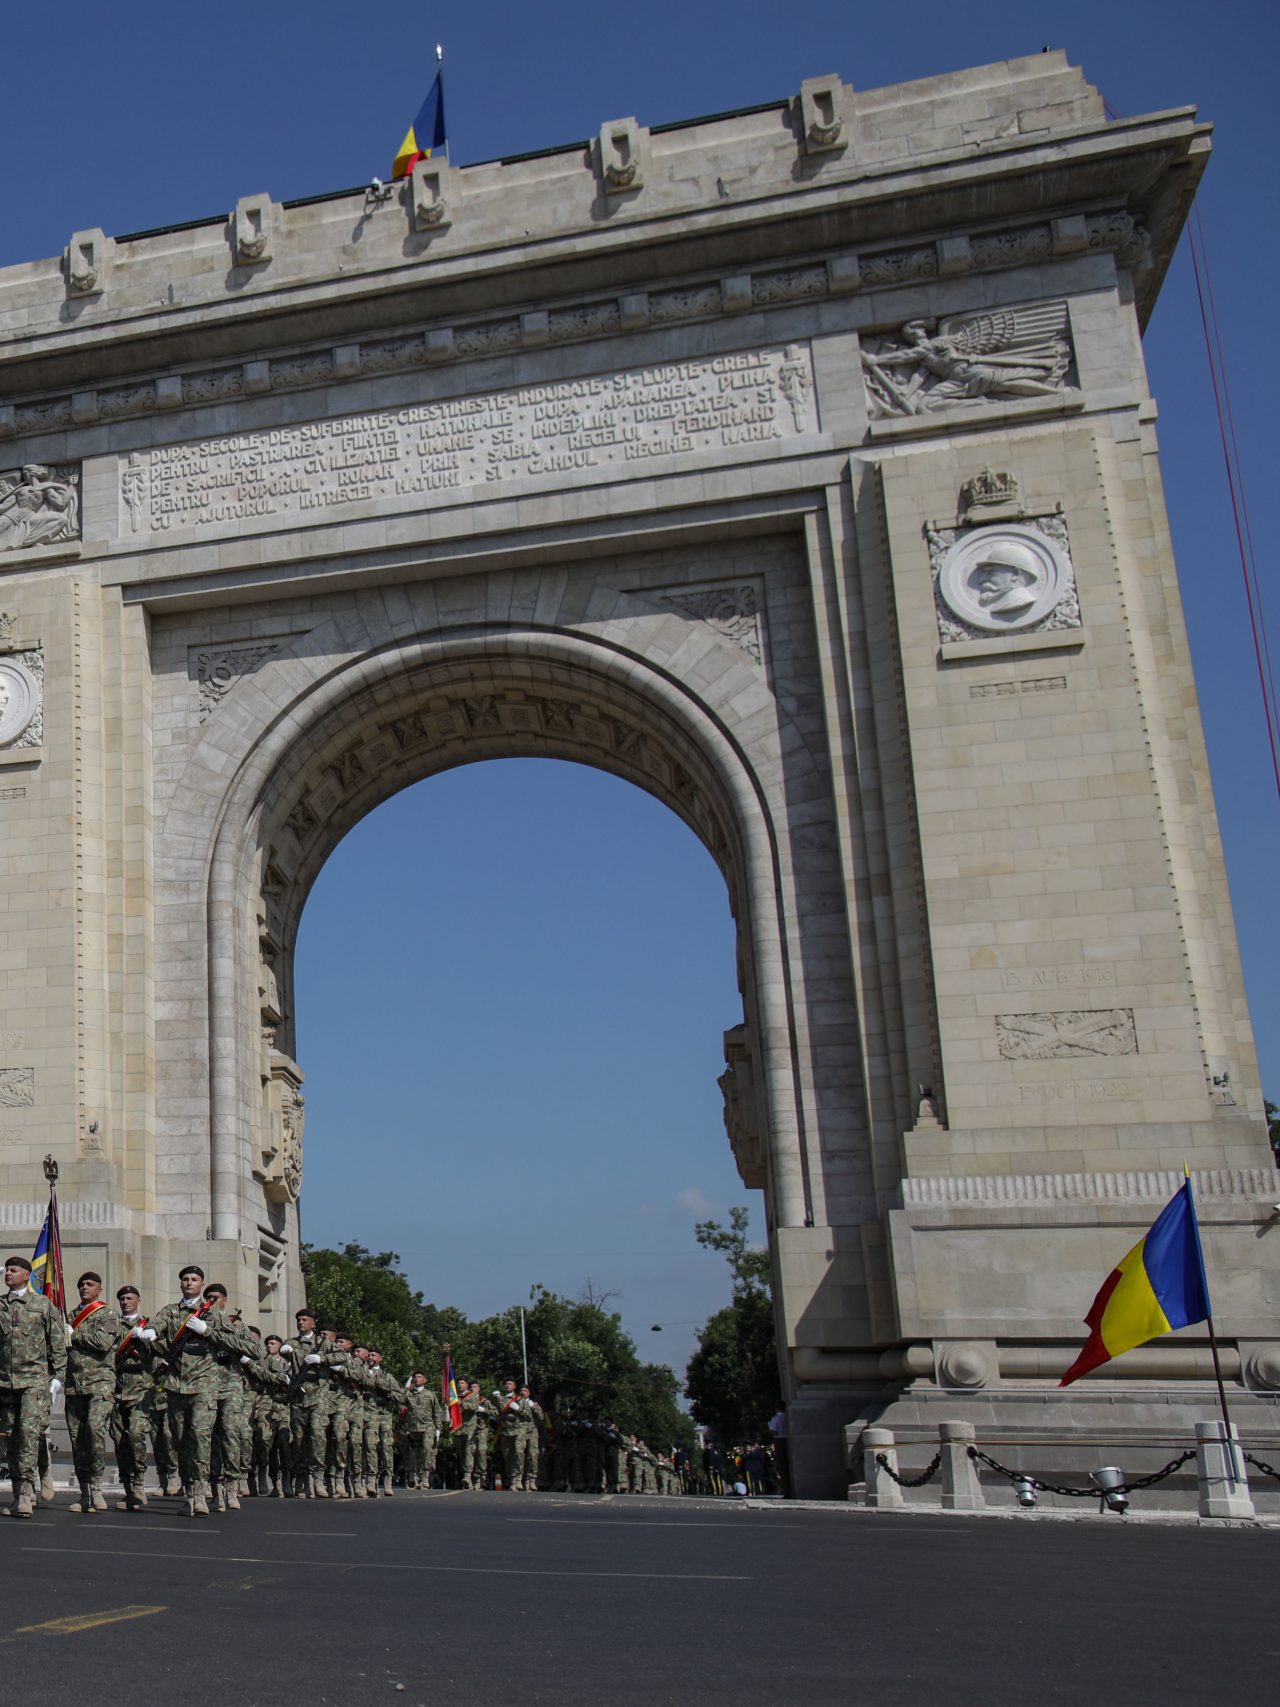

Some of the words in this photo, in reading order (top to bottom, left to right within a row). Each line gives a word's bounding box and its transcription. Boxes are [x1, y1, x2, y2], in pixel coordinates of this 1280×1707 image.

[150, 444, 189, 465] DUPA
[199, 433, 259, 457] SECOLE
[269, 428, 289, 446] DE
[300, 412, 388, 441] SUFERINTE
[397, 393, 506, 426] CRESTINESTE
[517, 378, 600, 406] INDURATE
[612, 373, 630, 391] SI
[641, 362, 699, 386] LUPTE
[711, 350, 771, 375] GRELE
[150, 458, 209, 481] PENTRU
[229, 440, 323, 469] PASTRAREA
[342, 428, 398, 451] FIINTEI
[419, 409, 512, 439] NATIONALE
[534, 399, 579, 421] DUPA
[598, 380, 696, 411] APARAREA
[718, 368, 775, 393] PLINA
[150, 481, 170, 498] DE
[278, 463, 290, 478] A
[304, 445, 400, 474] CIVILIZATIEI
[416, 434, 474, 457] UMANE
[491, 428, 513, 445] SE
[531, 412, 615, 439] INDEPLINI
[633, 393, 737, 423] DREPTATEA
[757, 387, 775, 404] SI
[151, 492, 209, 514] PENTRU
[237, 476, 310, 501] POPORUL
[337, 463, 394, 486] ROMAN
[420, 453, 459, 474] PRIN
[487, 441, 540, 464] SABIA
[568, 425, 641, 451] REGELUI
[672, 405, 777, 436] FERDINAND
[151, 514, 170, 531] CU
[195, 498, 276, 525] AJUTORUL
[395, 470, 460, 495] NATIUNI
[485, 464, 503, 481] SI
[624, 435, 694, 461] REGINEI
[721, 422, 781, 446] MARIA
